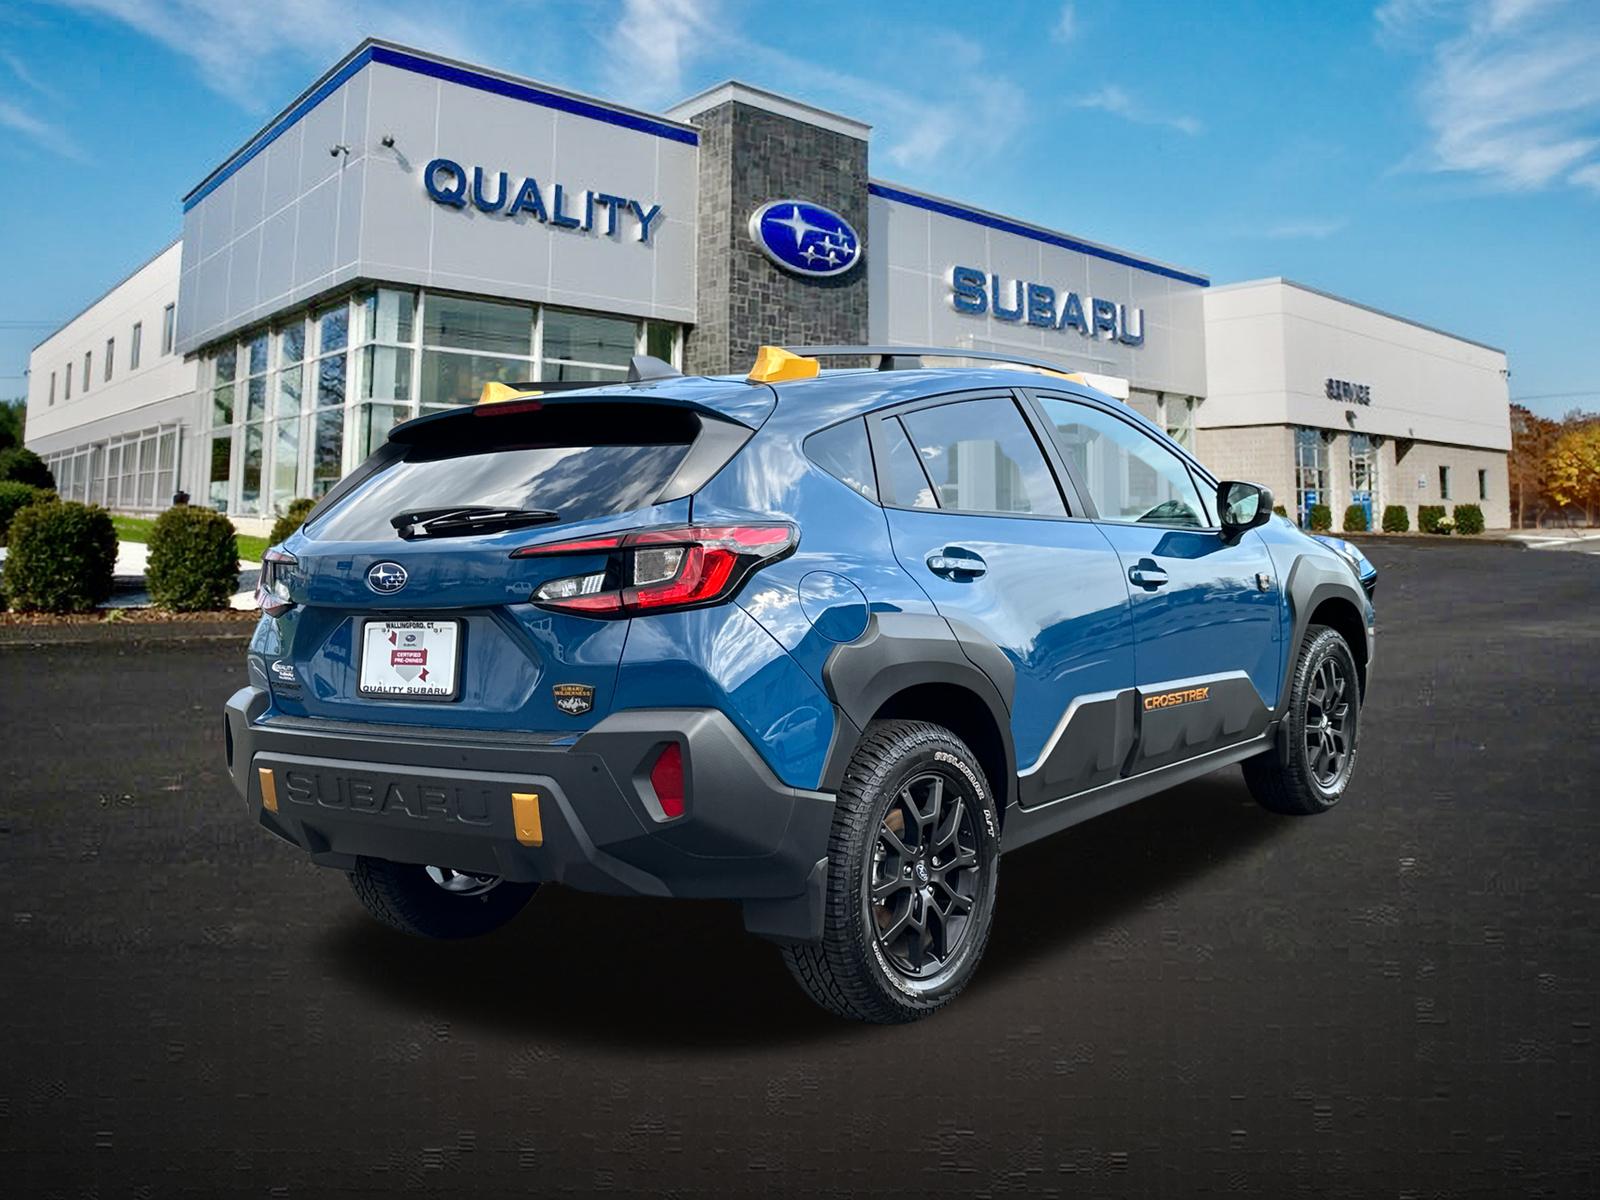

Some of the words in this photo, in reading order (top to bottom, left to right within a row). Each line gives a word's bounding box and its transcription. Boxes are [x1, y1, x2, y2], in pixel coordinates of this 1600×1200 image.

[424, 157, 662, 243] QUALITY
[945, 265, 1146, 347] SUBARU
[1325, 378, 1371, 407] SERVICE
[362, 684, 404, 694] QUALITY
[406, 686, 448, 695] SUBARU
[1144, 687, 1209, 710] CROSSTREK
[286, 771, 493, 826] SUBARU
